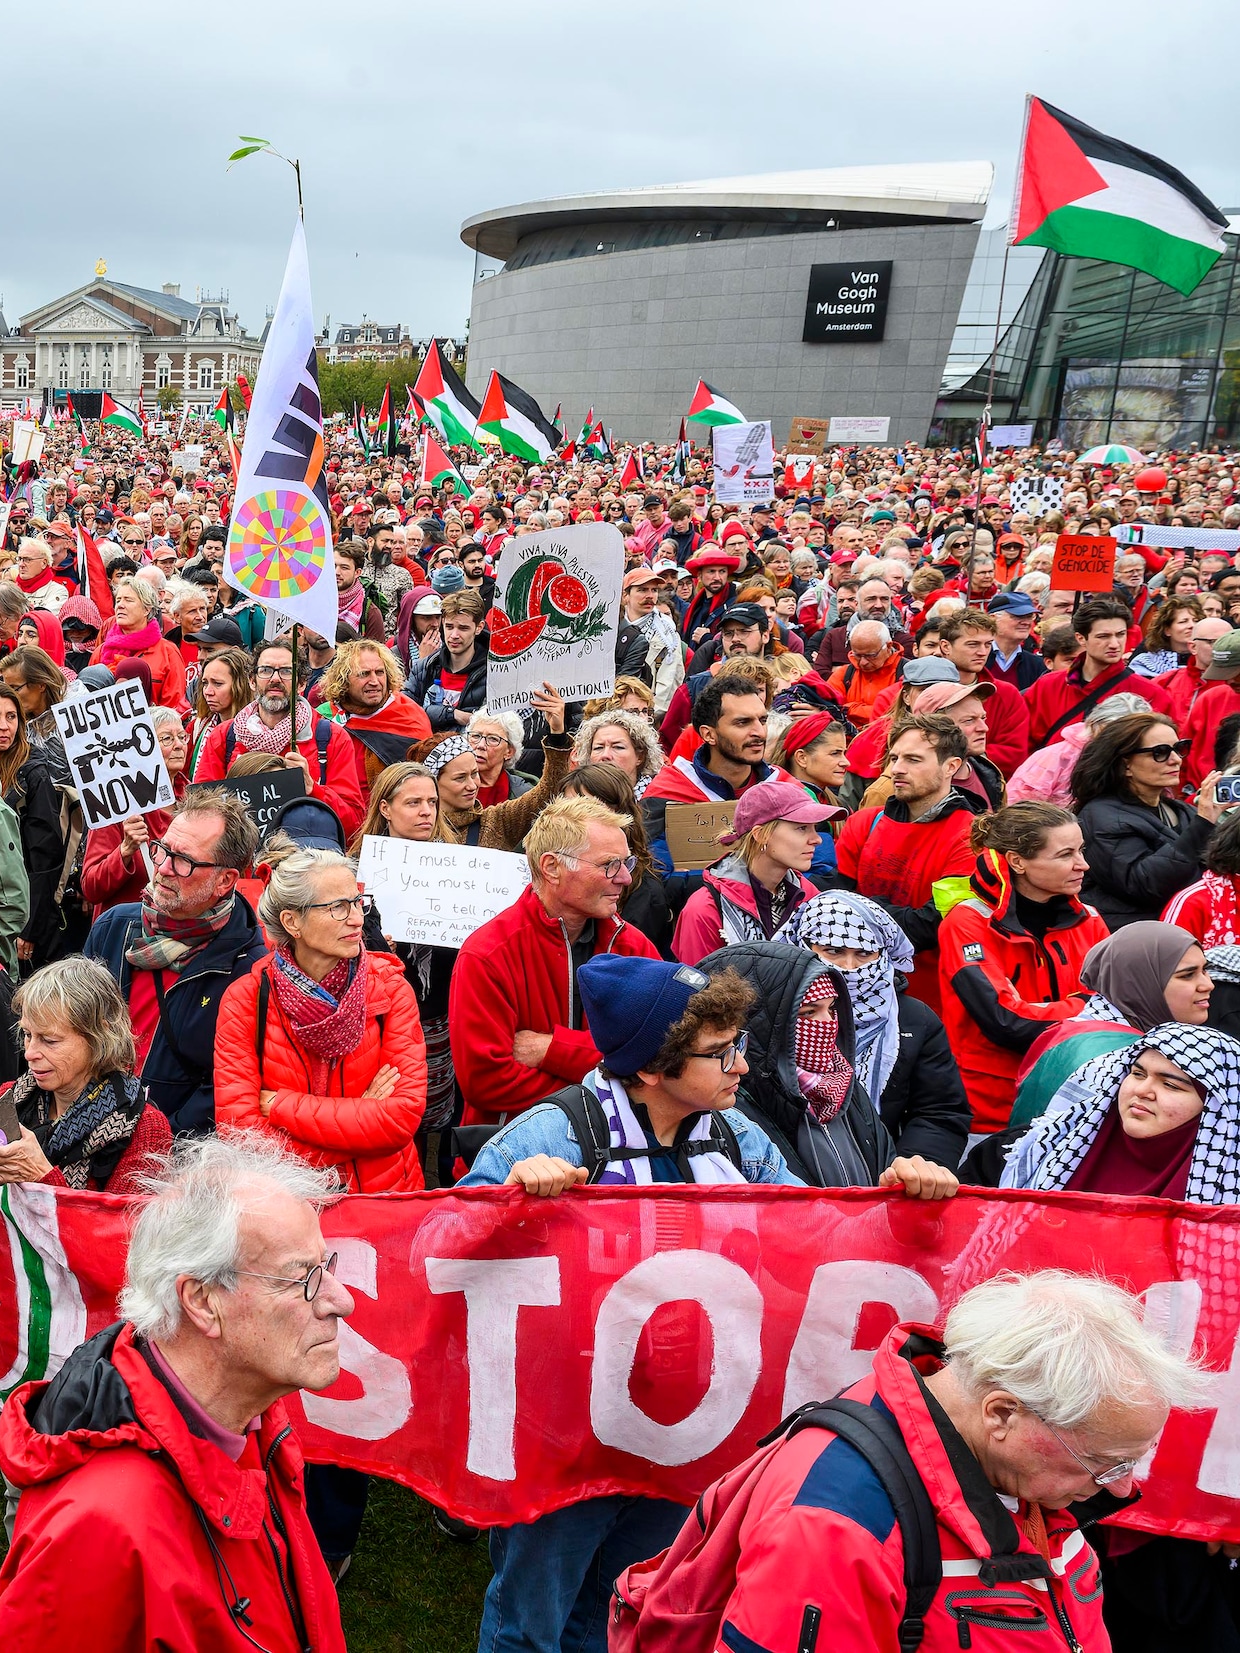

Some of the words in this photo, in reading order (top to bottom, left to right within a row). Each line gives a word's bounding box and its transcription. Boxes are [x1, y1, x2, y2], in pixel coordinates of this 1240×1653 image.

[851, 272, 879, 284] Van
[838, 286, 877, 301] Gogh
[816, 302, 875, 315] Museum
[825, 323, 873, 331] Amsterdam
[1061, 543, 1087, 557] STOP
[1091, 545, 1105, 559] DE
[550, 542, 568, 560] VIVA
[567, 556, 601, 599] PALESTINA
[1058, 559, 1111, 574] GENOCIDE
[490, 664, 509, 673] VIVA
[512, 651, 533, 670] VIVA
[536, 643, 571, 662] INTIFADA
[58, 685, 146, 739] JUSTICE
[81, 764, 160, 824] NOW
[262, 784, 281, 802] AL
[373, 840, 388, 861] If
[401, 845, 409, 864] I
[420, 851, 457, 867] must
[468, 858, 490, 870] die
[438, 879, 476, 890] must
[485, 882, 509, 896] live
[425, 898, 441, 912] To
[453, 903, 476, 915] tell
[483, 907, 498, 918] m
[408, 917, 443, 928] REFAAT
[405, 929, 426, 940] (1979
[440, 931, 447, 941] 6
[452, 932, 463, 943] de
[964, 945, 982, 955] HH
[300, 1237, 940, 1480] STOP
